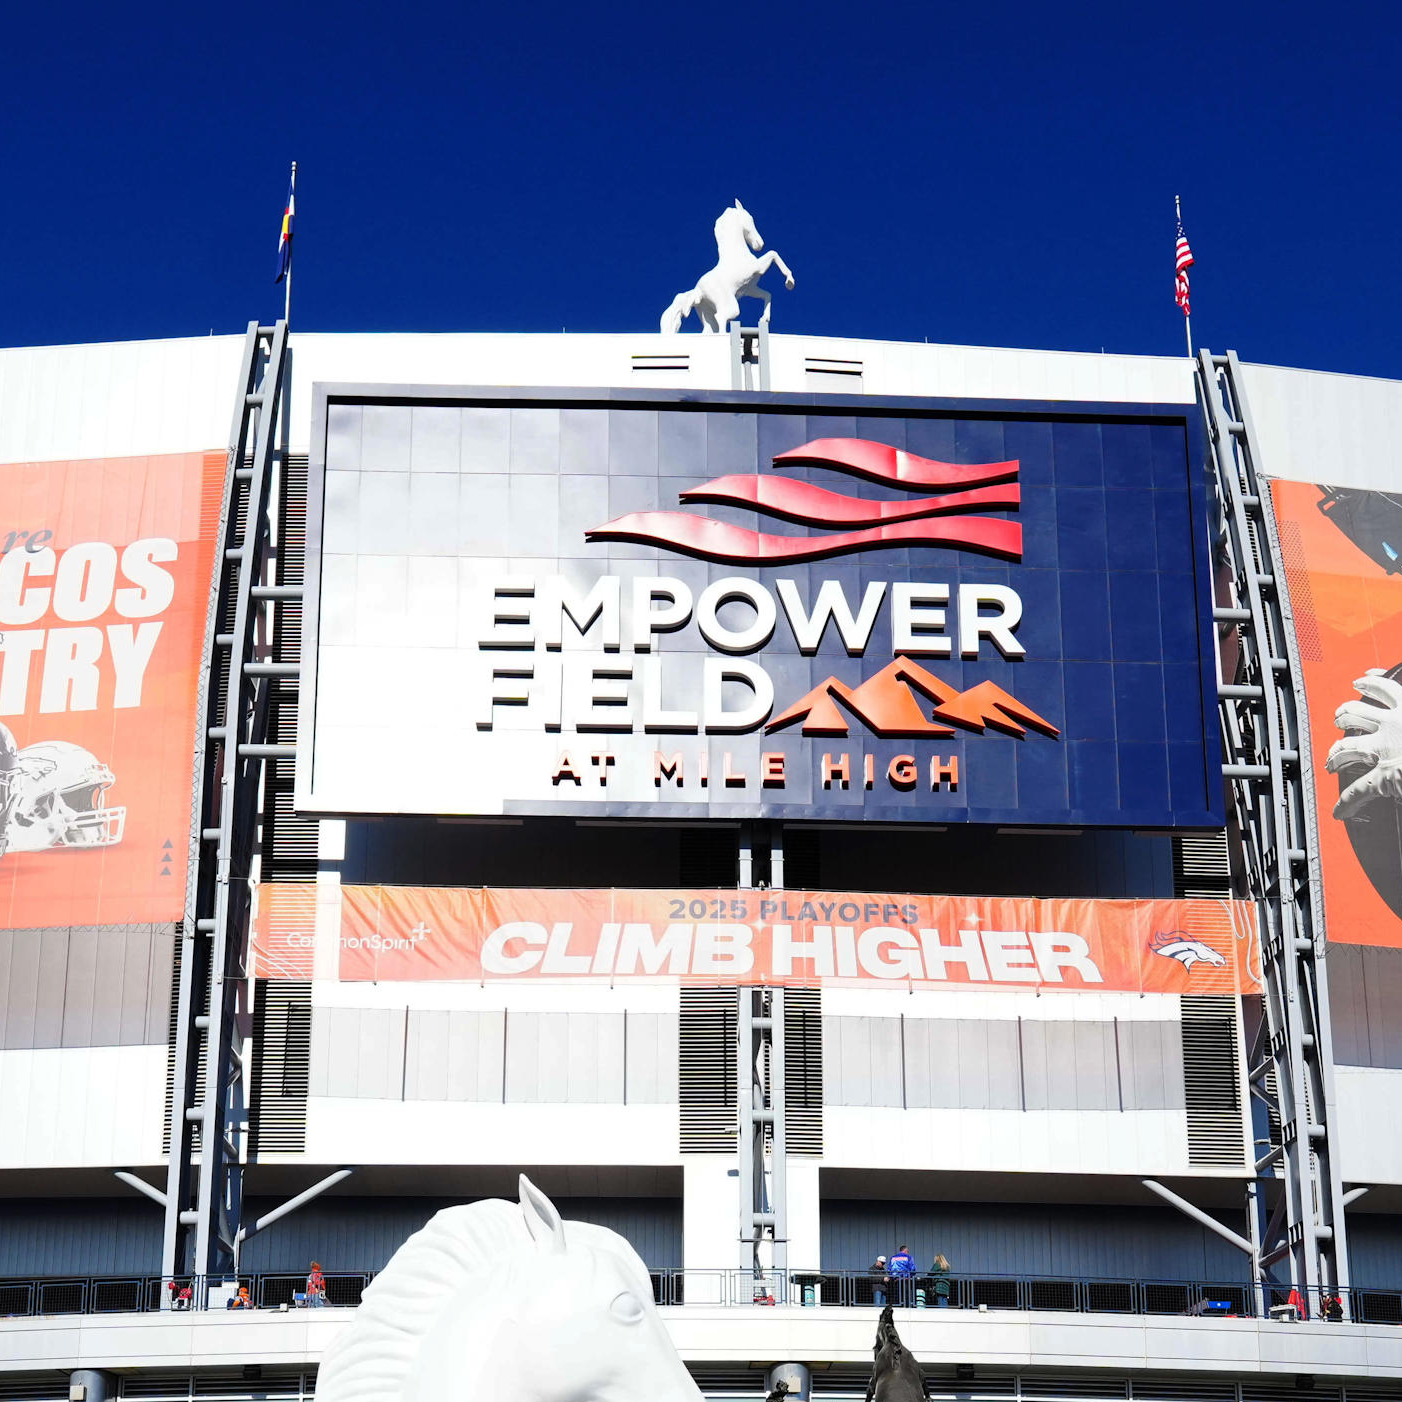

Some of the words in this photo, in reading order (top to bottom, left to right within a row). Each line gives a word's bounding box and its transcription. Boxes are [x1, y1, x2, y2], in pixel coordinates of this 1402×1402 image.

[477, 575, 1027, 659] EMPOWER
[476, 654, 775, 733] FIELD
[552, 751, 616, 787] AT
[653, 750, 787, 789] MILE
[820, 752, 959, 793] HIGH
[668, 899, 748, 920] 2025
[760, 899, 920, 925] PLAYOFFS
[479, 922, 756, 975] CLIMB
[771, 923, 1103, 984] HIGHER
